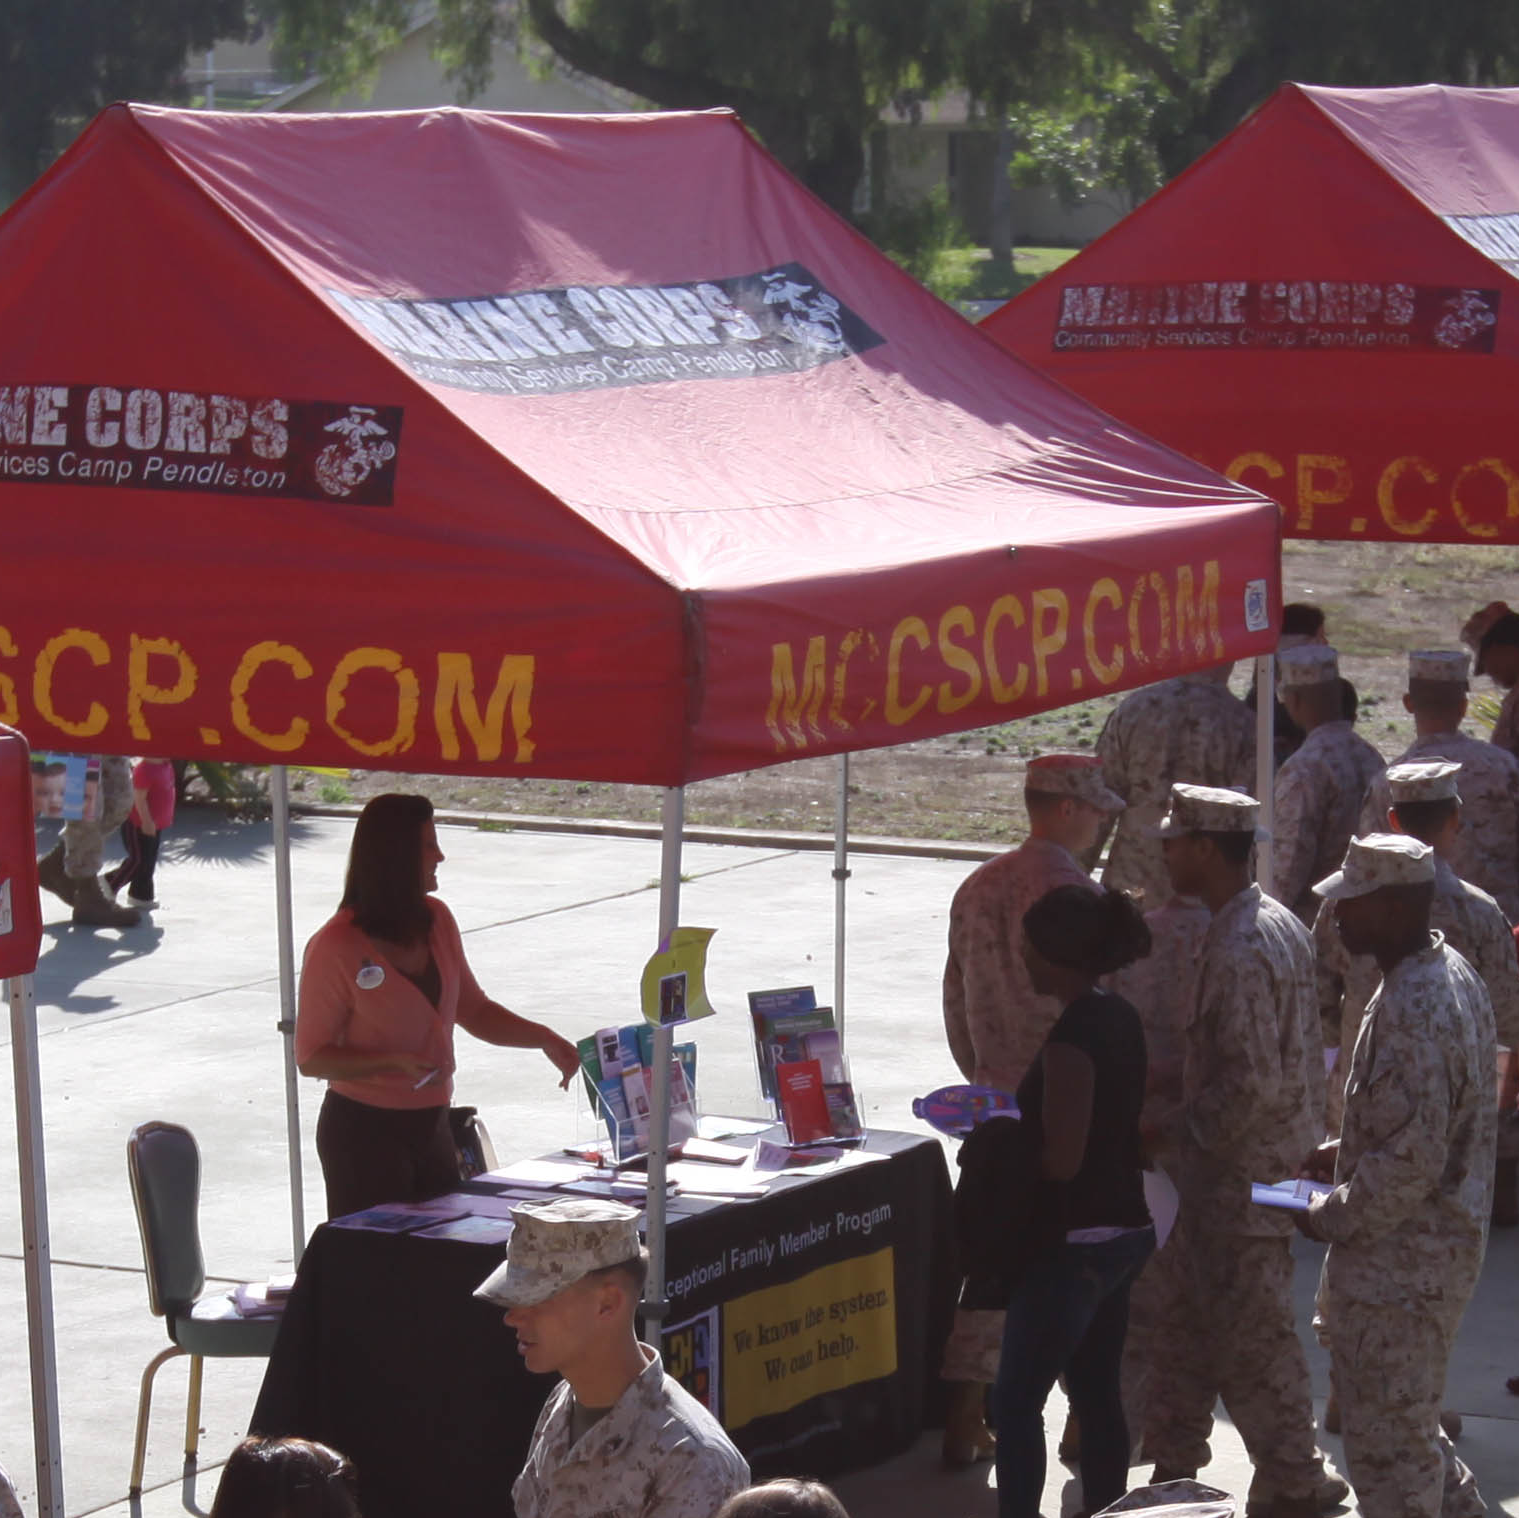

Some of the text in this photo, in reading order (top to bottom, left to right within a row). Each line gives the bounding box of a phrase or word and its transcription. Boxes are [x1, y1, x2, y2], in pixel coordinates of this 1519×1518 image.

[324, 282, 761, 361] MARINE CORPS
[1260, 281, 1416, 326] CORPS
[510, 358, 608, 390] Services
[602, 354, 672, 380] Camp
[681, 347, 786, 374] Pendleton
[85, 385, 290, 460] CORPS
[57, 450, 133, 482] Camp
[142, 454, 287, 490] Pendleton
[765, 560, 1225, 752] MCCSCP.COM
[665, 1203, 892, 1299] ceptional Family Member Program
[757, 1317, 801, 1347] know
[804, 1305, 825, 1330] the
